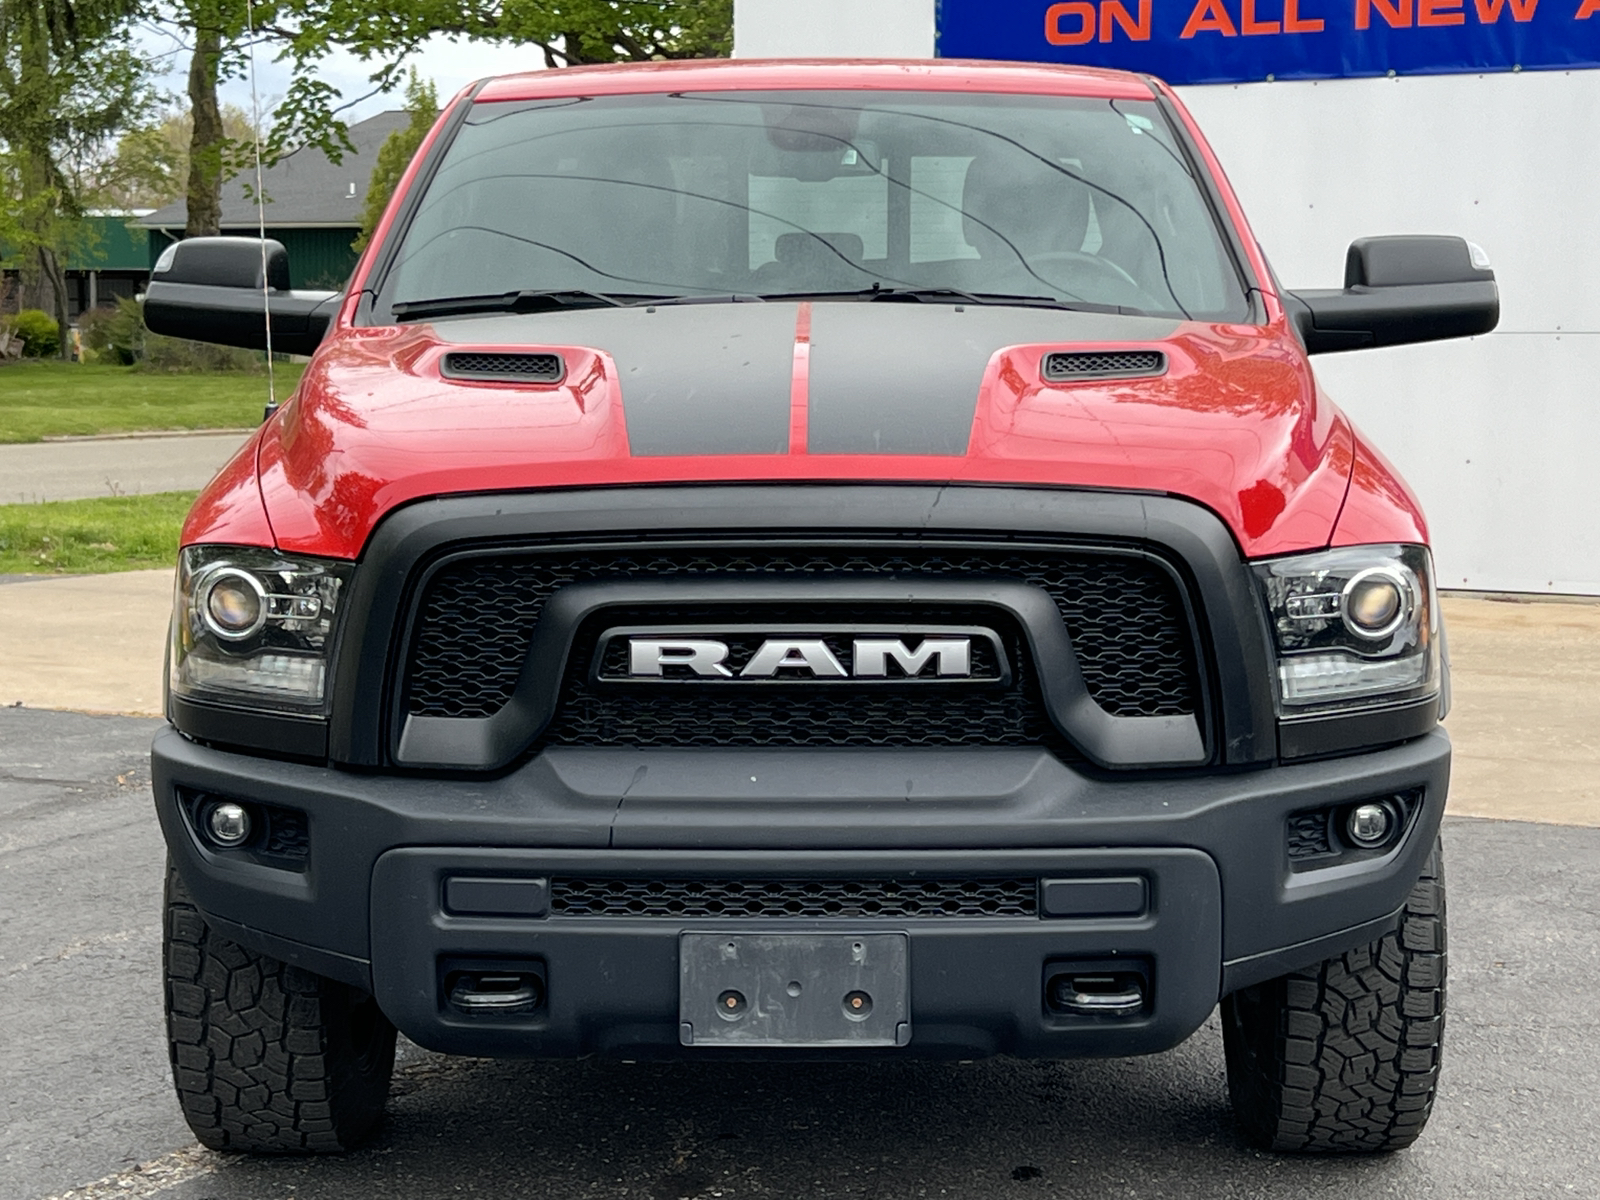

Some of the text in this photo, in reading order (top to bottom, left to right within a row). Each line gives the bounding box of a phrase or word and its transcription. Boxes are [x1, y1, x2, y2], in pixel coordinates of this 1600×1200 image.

[1045, 0, 1152, 45] ON
[1179, 0, 1325, 39] ALL
[628, 638, 971, 678] RAM
